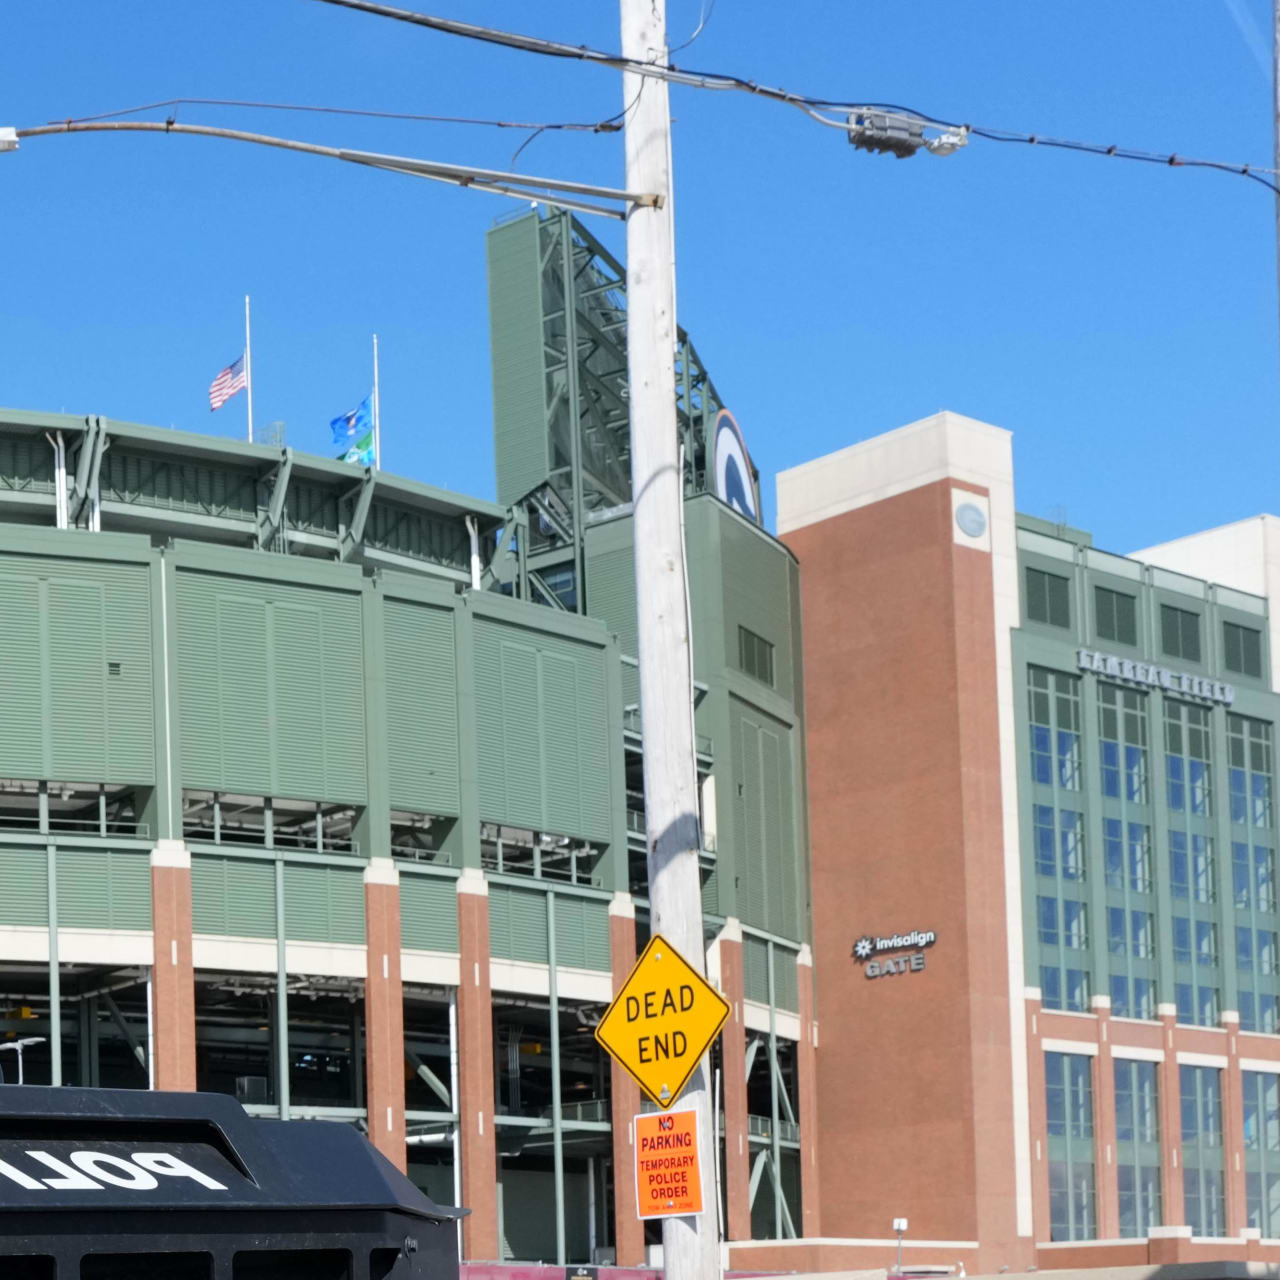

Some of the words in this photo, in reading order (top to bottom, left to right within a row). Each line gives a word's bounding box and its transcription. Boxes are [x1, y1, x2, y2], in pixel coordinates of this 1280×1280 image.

[1181, 673, 1236, 704] FIELD
[876, 931, 935, 950] invisalign
[866, 953, 925, 977] GATE
[626, 984, 695, 1023] DEAD
[638, 1030, 688, 1064] END
[658, 1116, 674, 1132] NO
[641, 1132, 692, 1152] PARKING
[640, 1155, 695, 1172] TEMPORARY
[648, 1171, 688, 1186] POLICE
[651, 1185, 688, 1200] ORDER
